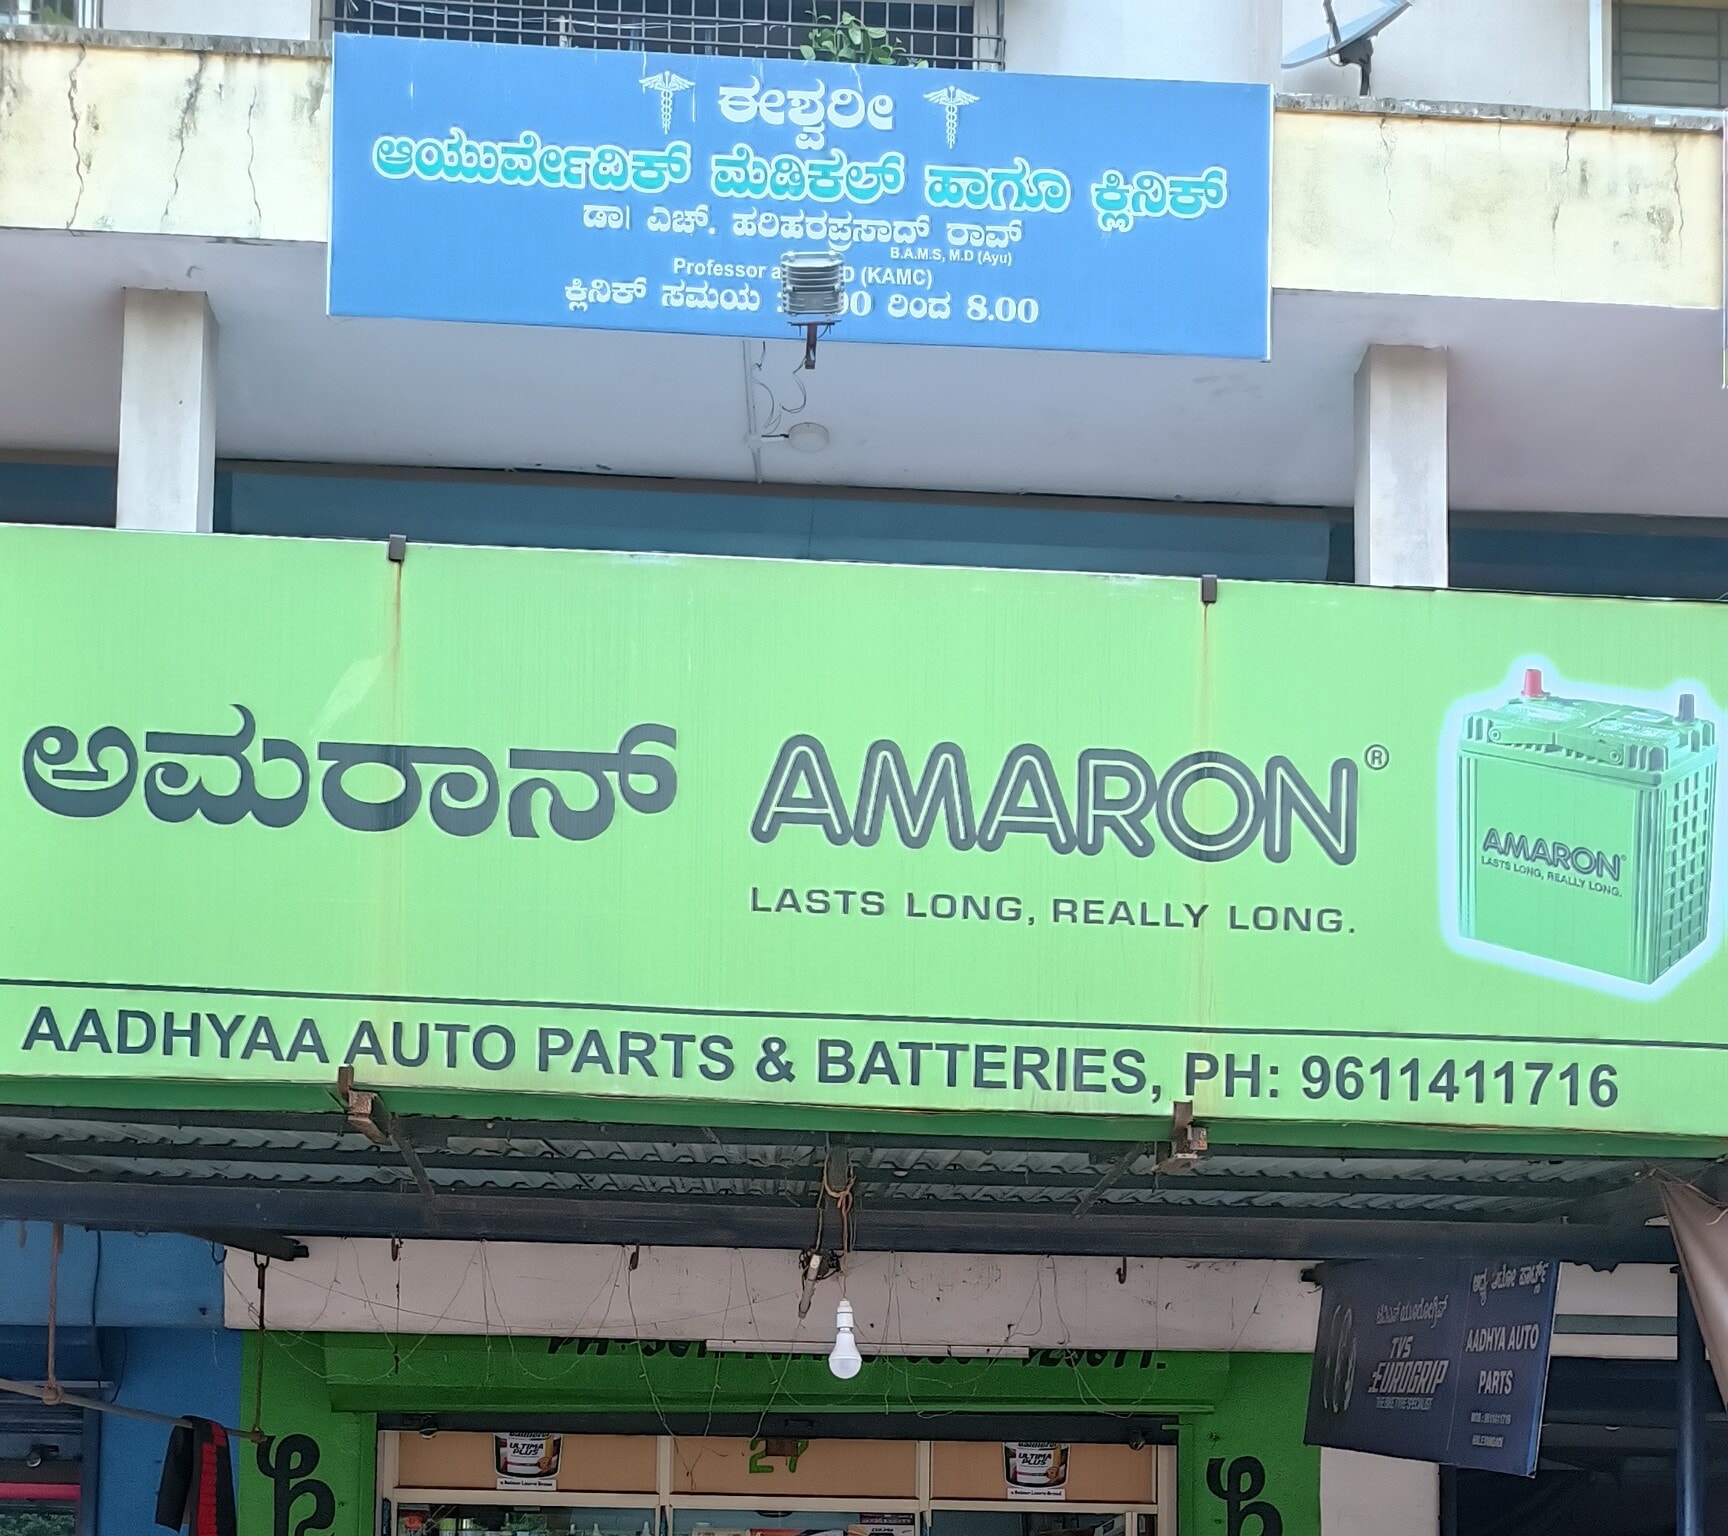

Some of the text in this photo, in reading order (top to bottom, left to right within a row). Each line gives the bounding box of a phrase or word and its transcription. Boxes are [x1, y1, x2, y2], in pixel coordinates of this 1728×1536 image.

[372, 127, 1228, 232] ಆಯುರ್ವೇದಿಕ್ ಮೆಡಿಕಲ್ ಹಾಗೂ ಕ್ಲಿನಿಕ್
[732, 206, 930, 251] ಹರಿಹರಪ್ರಸಾದ್
[946, 219, 1022, 248] ರಾವ್
[673, 257, 767, 279] Professor
[861, 267, 933, 289] (KAMC)
[977, 251, 1012, 266] (Ayu)
[564, 276, 647, 312] ಕ್ಲಿನಿಕ್
[661, 279, 761, 311] ಸಮಯ
[887, 291, 951, 320] ರಿಂದ
[966, 293, 1040, 323] 8.00
[22, 703, 678, 841] ಅಮರಾನ್
[750, 733, 1359, 866] AMARON
[1481, 855, 1623, 897] LASTS LONG, REALLY LONG.
[1482, 828, 1621, 882] AMARON
[750, 887, 1357, 934] LASTS LONG, REALLY LONG.
[21, 1005, 1619, 1108] AADHYAA AUTO PARTS & BATTERIES, PH: 9611411716
[1389, 1335, 1414, 1359] TVS
[1465, 1323, 1540, 1352] AADHYA AUTO
[1367, 1360, 1450, 1394] EUROGRIP
[1477, 1369, 1513, 1395] PARTS
